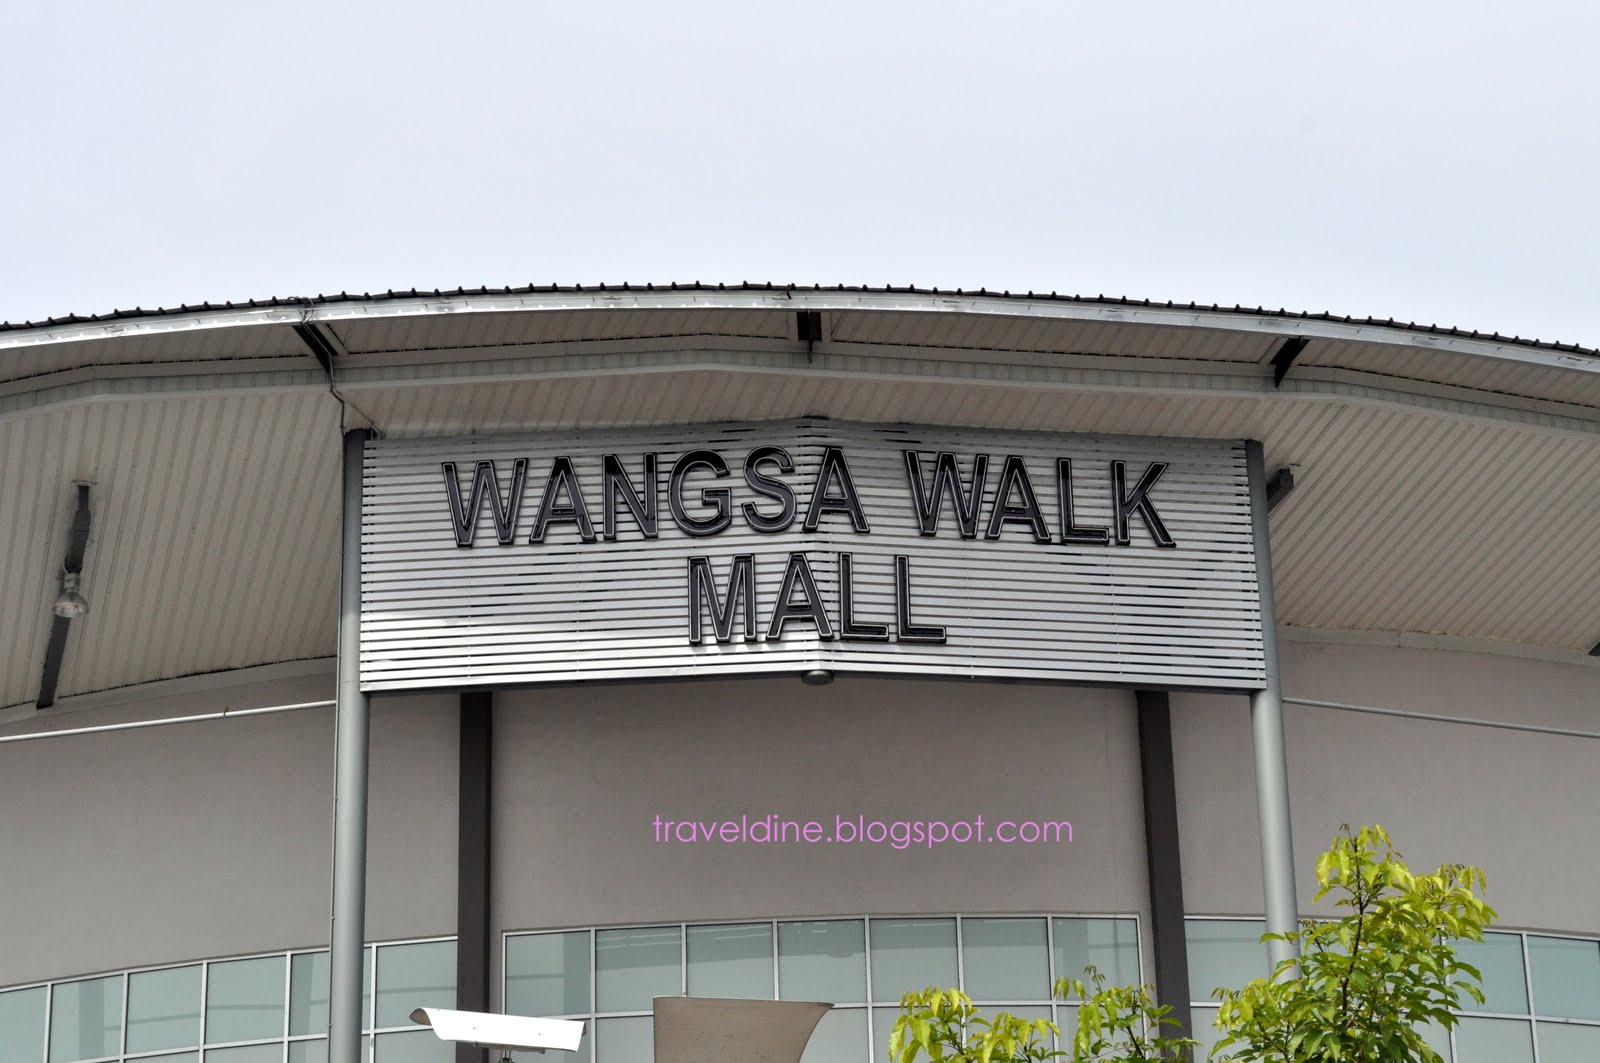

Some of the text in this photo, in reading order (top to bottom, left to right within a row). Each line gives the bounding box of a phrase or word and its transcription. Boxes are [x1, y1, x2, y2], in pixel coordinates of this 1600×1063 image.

[441, 445, 1176, 548] WANGSA WALK
[688, 552, 947, 646] MALL
